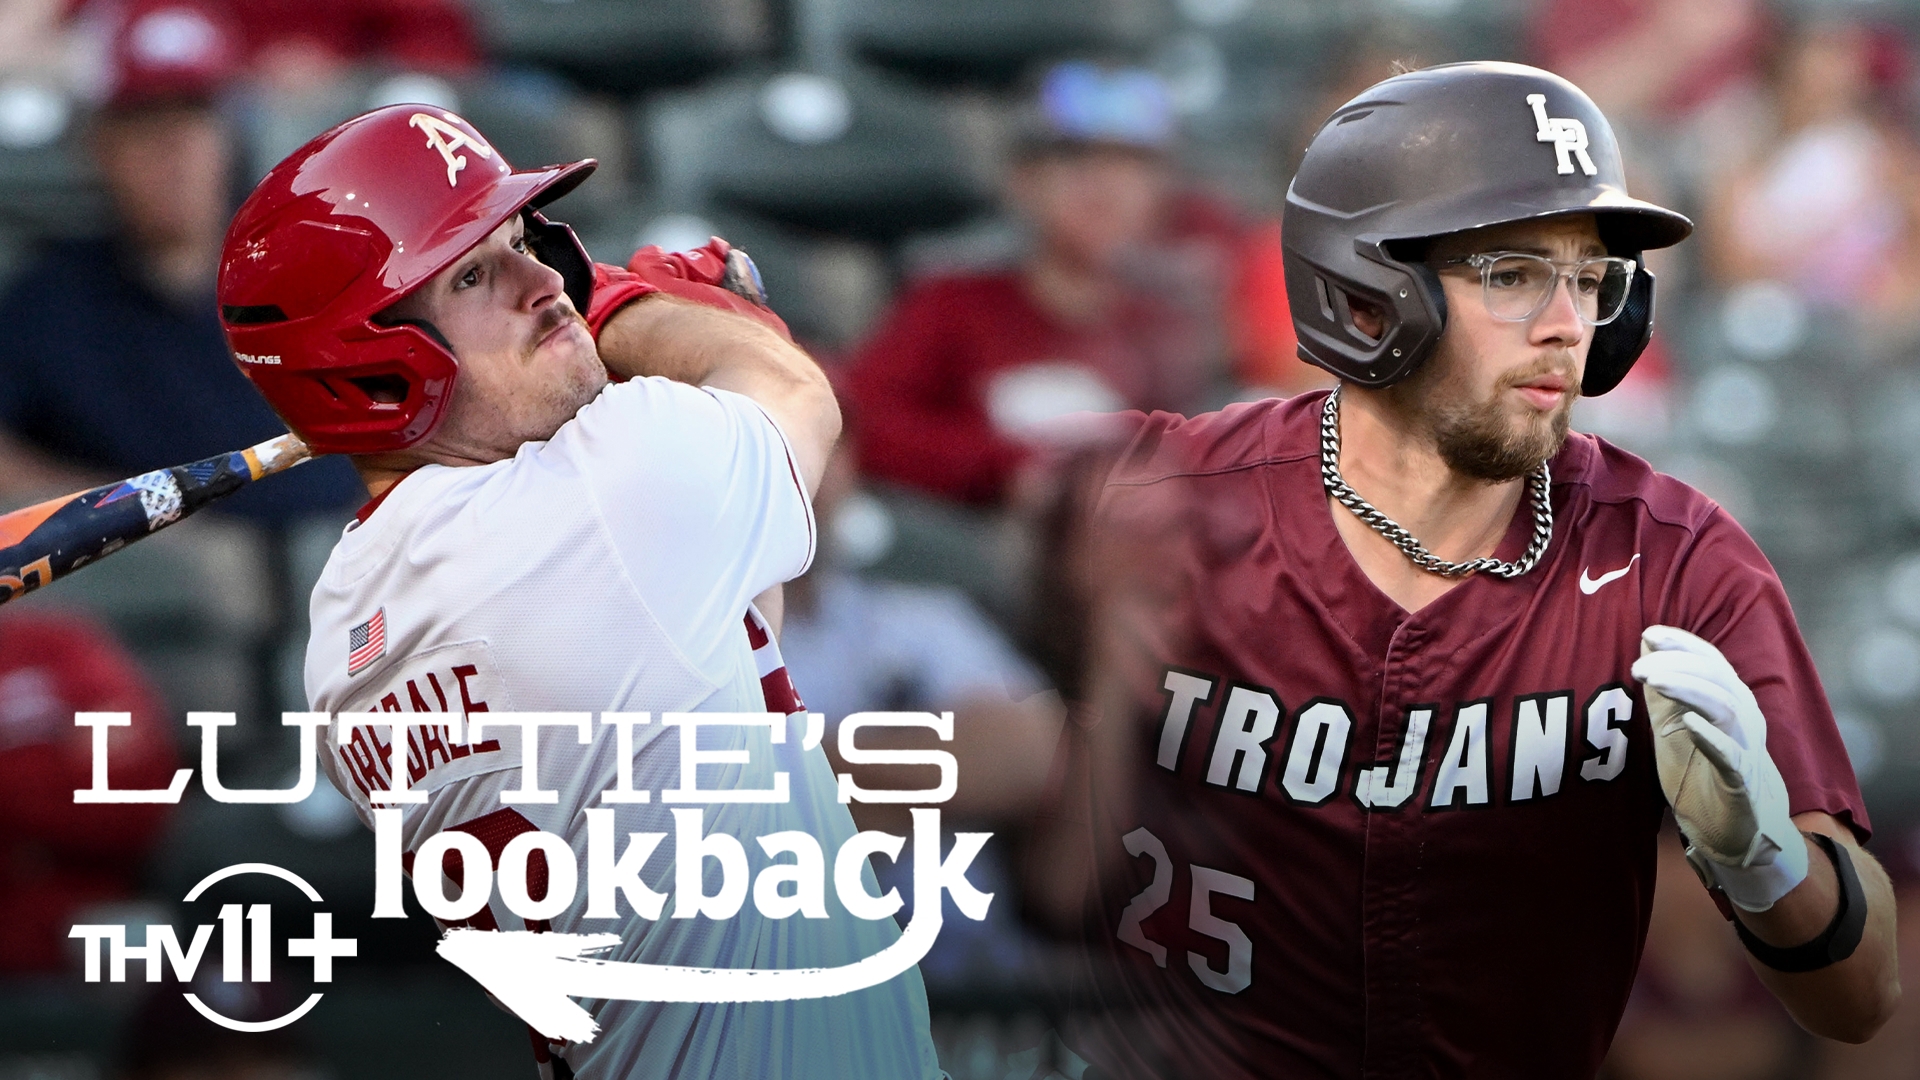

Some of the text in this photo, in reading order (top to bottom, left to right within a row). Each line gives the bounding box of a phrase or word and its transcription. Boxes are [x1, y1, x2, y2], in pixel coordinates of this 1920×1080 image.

[408, 112, 492, 188] A
[1525, 93, 1598, 176] LR
[1154, 669, 1634, 809] TROJANS
[1115, 825, 1256, 995] 25
